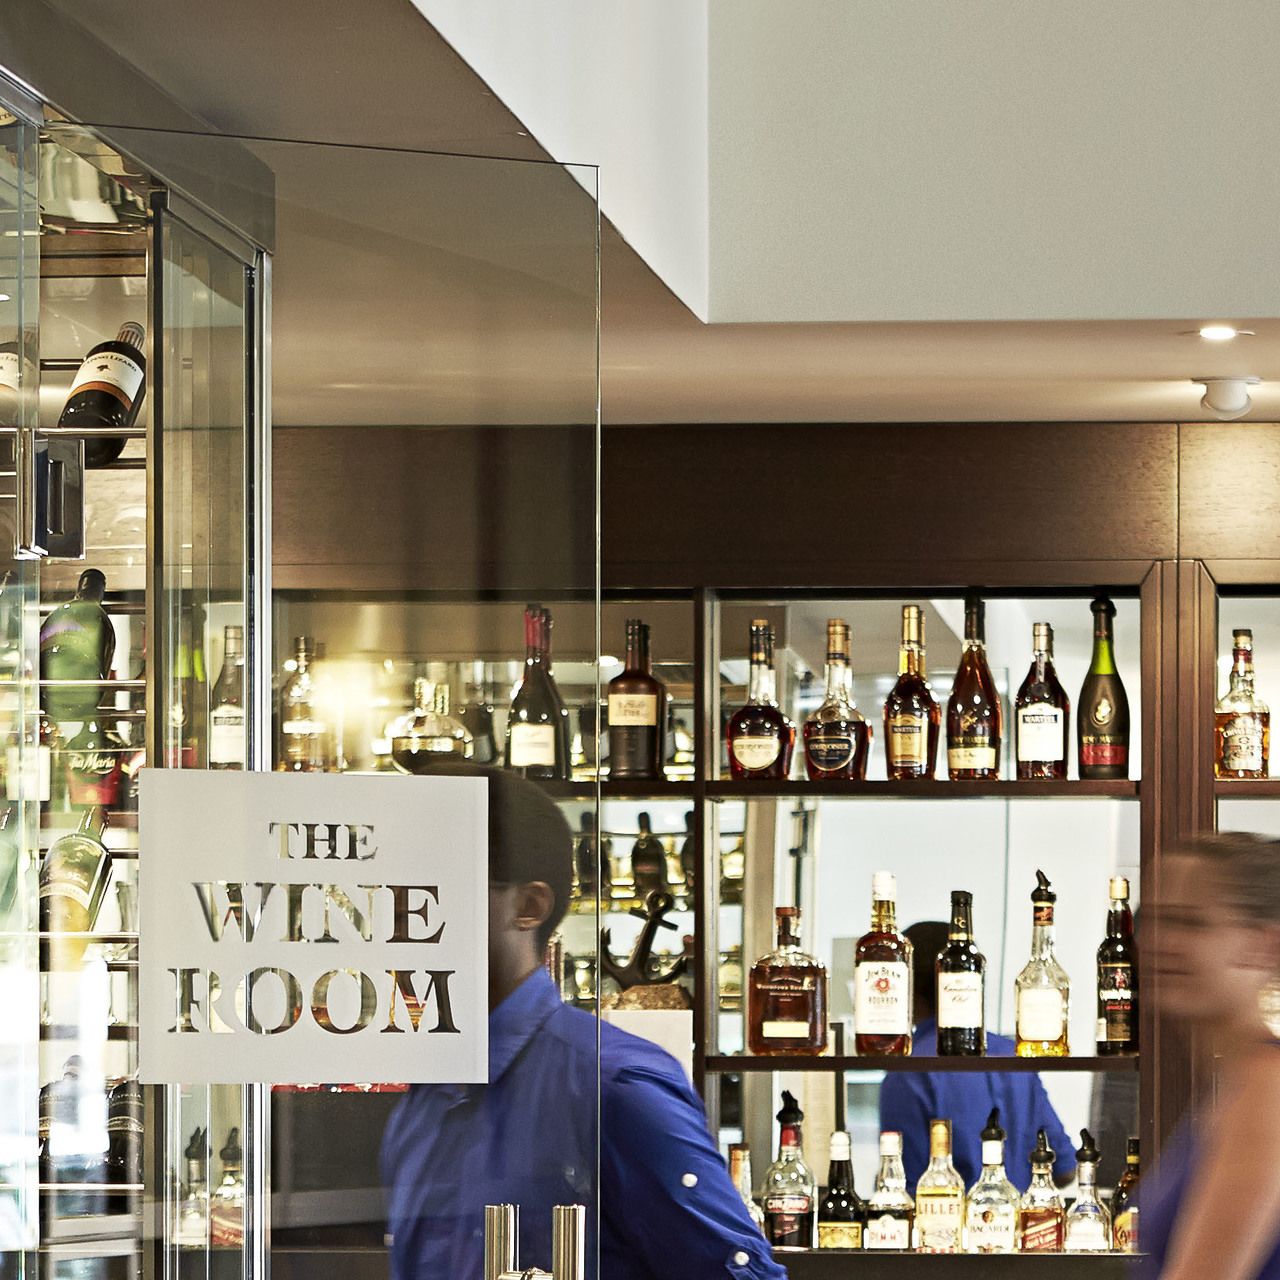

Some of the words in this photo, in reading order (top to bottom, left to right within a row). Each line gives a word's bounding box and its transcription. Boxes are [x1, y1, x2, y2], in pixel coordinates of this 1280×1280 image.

[109, 355, 137, 372] LIZARD
[269, 822, 378, 860] THE
[191, 882, 446, 944] WINE
[166, 966, 461, 1035] ROOM
[918, 1203, 961, 1216] LILLET
